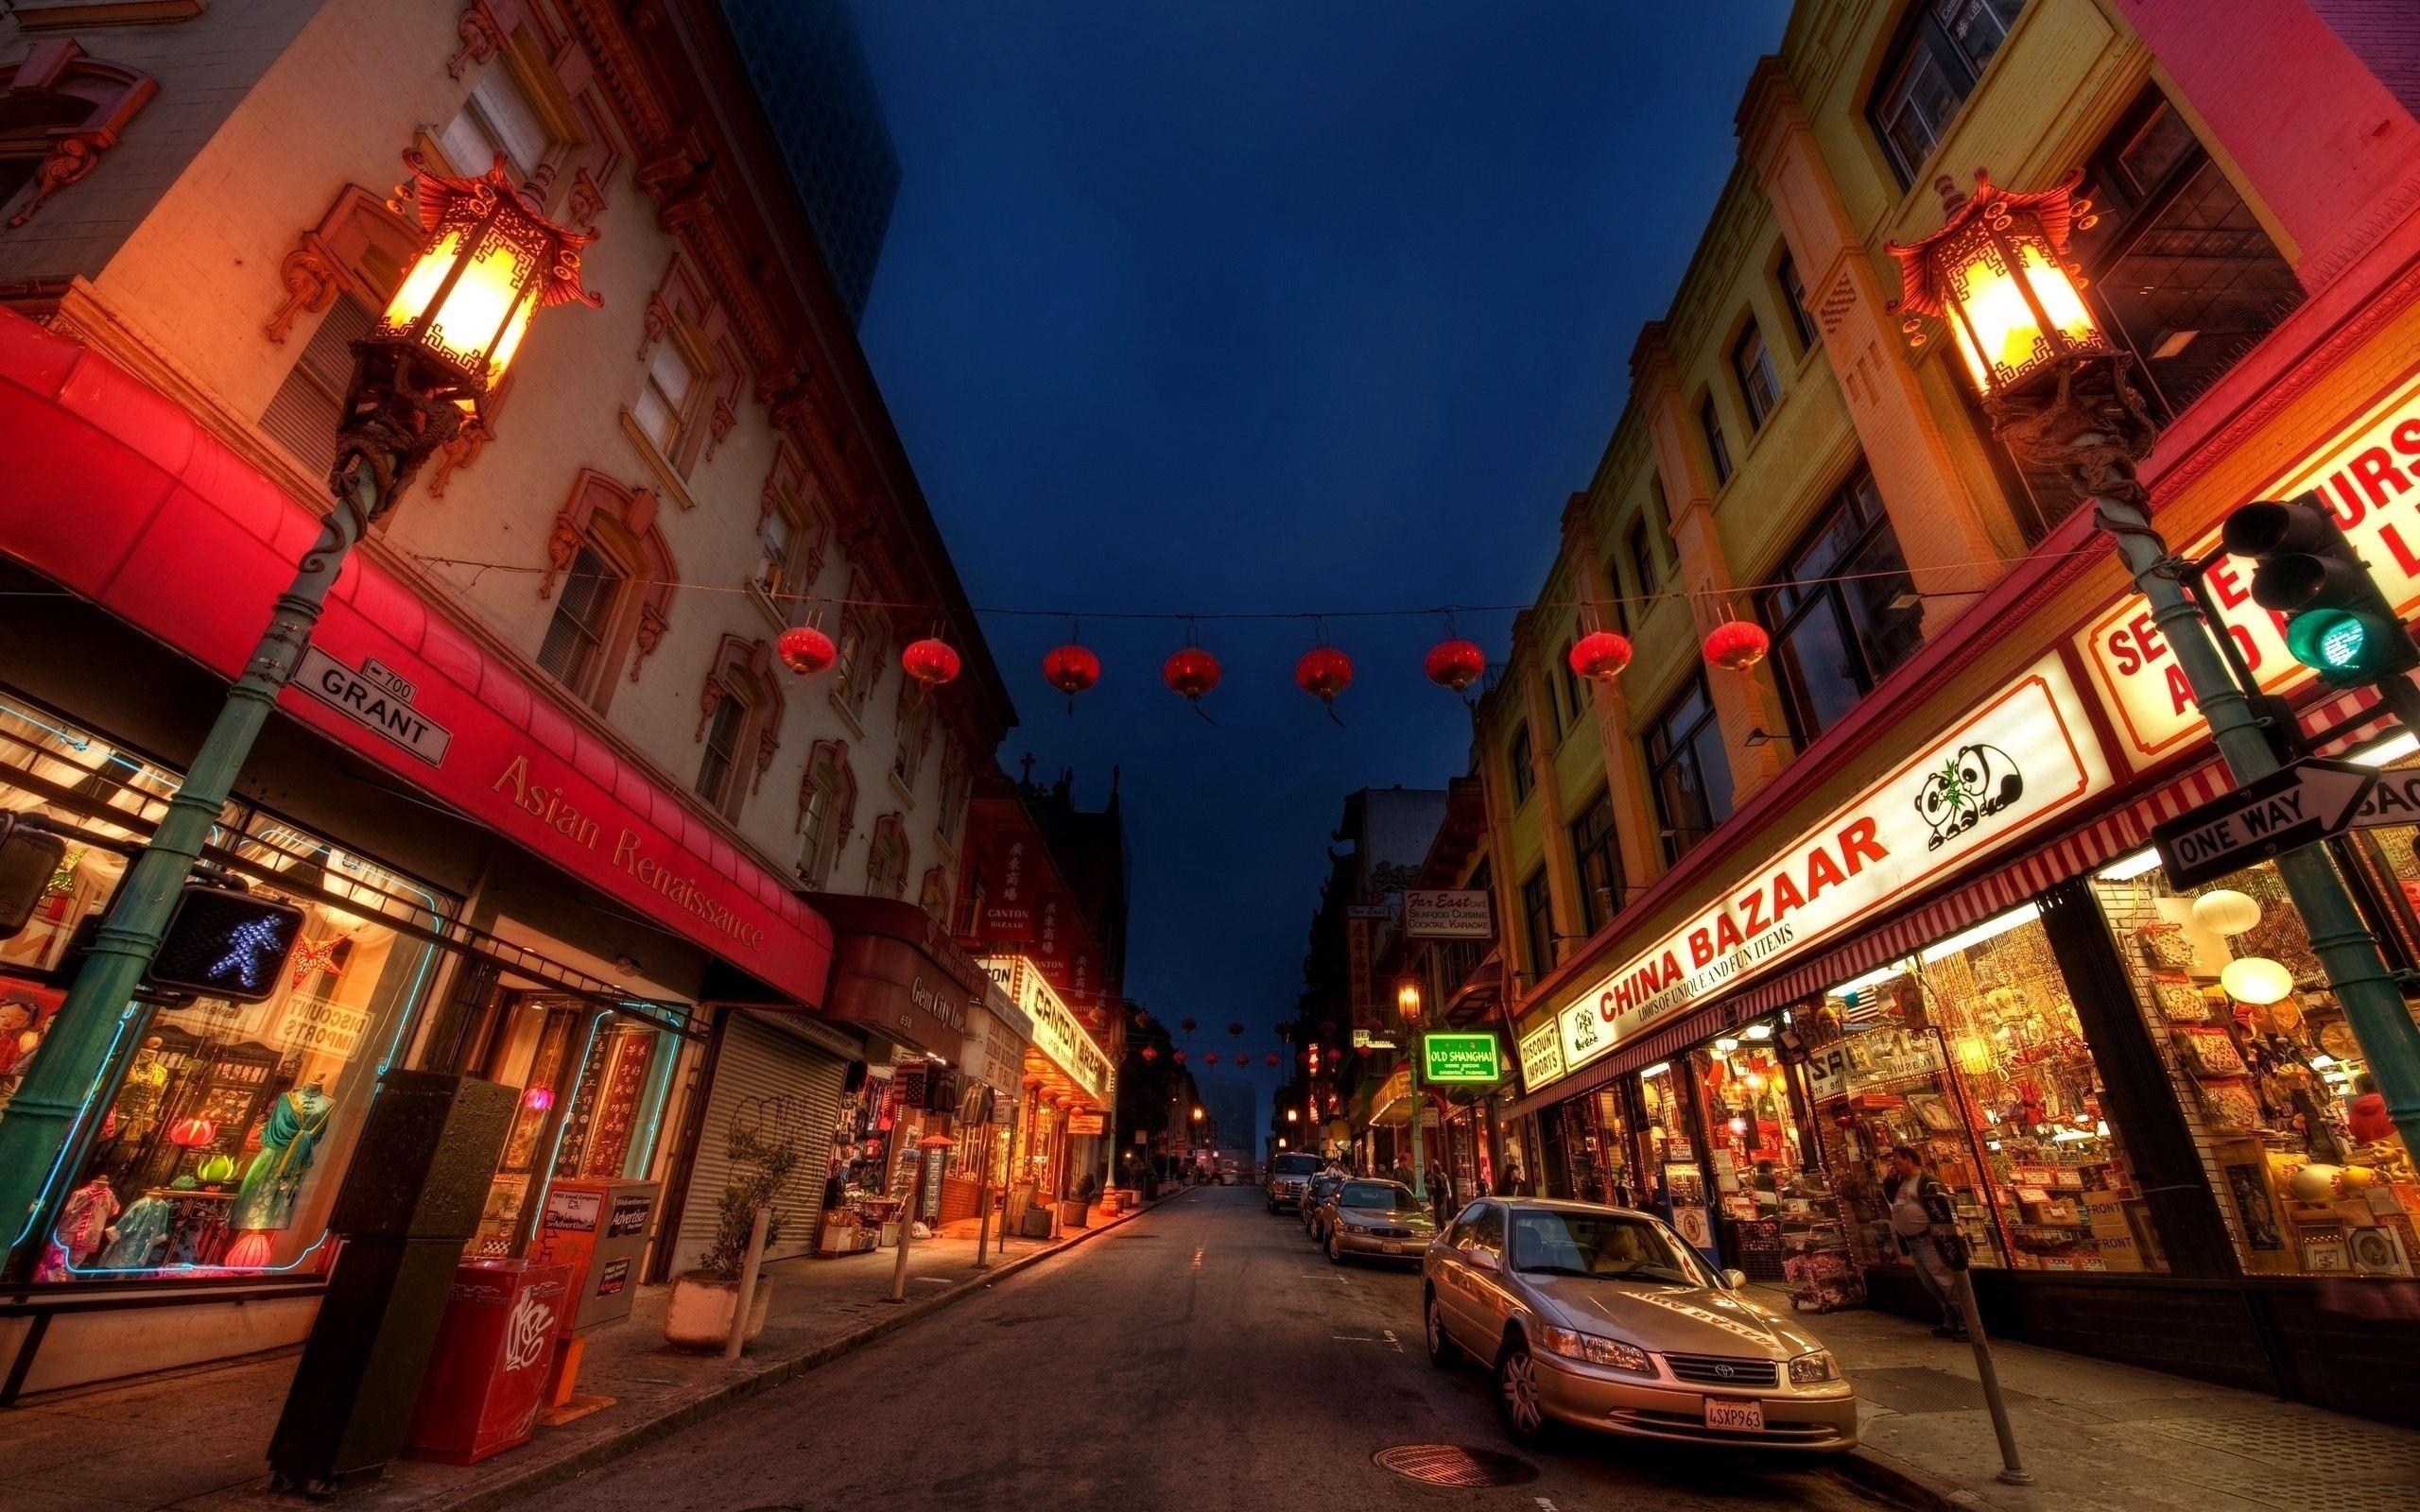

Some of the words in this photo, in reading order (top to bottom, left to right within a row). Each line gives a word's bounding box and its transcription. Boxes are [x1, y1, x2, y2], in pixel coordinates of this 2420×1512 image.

[2108, 556, 2251, 677] SEE
[2165, 625, 2262, 716] AD
[385, 672, 411, 698] 700
[321, 669, 428, 745] GRANT
[2178, 819, 2239, 864] ONE
[2238, 789, 2305, 838] WAY
[491, 755, 601, 851] Asian
[612, 828, 766, 954] Renaissance
[1408, 892, 1433, 908] Far
[1435, 893, 1470, 908] East
[987, 909, 1028, 919] CANTON
[990, 920, 1024, 929] BAZAAR
[1408, 919, 1448, 929] COCKTAIL
[1449, 919, 1490, 929] KARAOKE
[1409, 909, 1450, 919] SEAFOOD
[1452, 909, 1488, 919] CUISINE
[1599, 950, 1685, 1023] CHINA
[1687, 816, 1892, 971] BAZAAR
[1036, 960, 1064, 970] ANTON
[1671, 972, 1707, 1005] UNIQUE
[1707, 960, 1729, 987] AND
[1729, 946, 1754, 973] FUN
[1753, 922, 1795, 959] ITEMS
[911, 976, 933, 1013] Gem
[933, 991, 950, 1031] City
[1033, 988, 1078, 1052] CANTON
[1430, 1051, 1448, 1062] OLD
[1449, 1051, 1493, 1062] SHANGHAI
[1522, 1027, 1556, 1064] DISCOUNT
[1527, 1050, 1558, 1083] IMPORTS
[612, 1210, 648, 1226] Advertiser
[2086, 1202, 2120, 1213] FRONT
[2098, 1237, 2132, 1248] FRONT
[1709, 1408, 1761, 1428] 4SXP963
